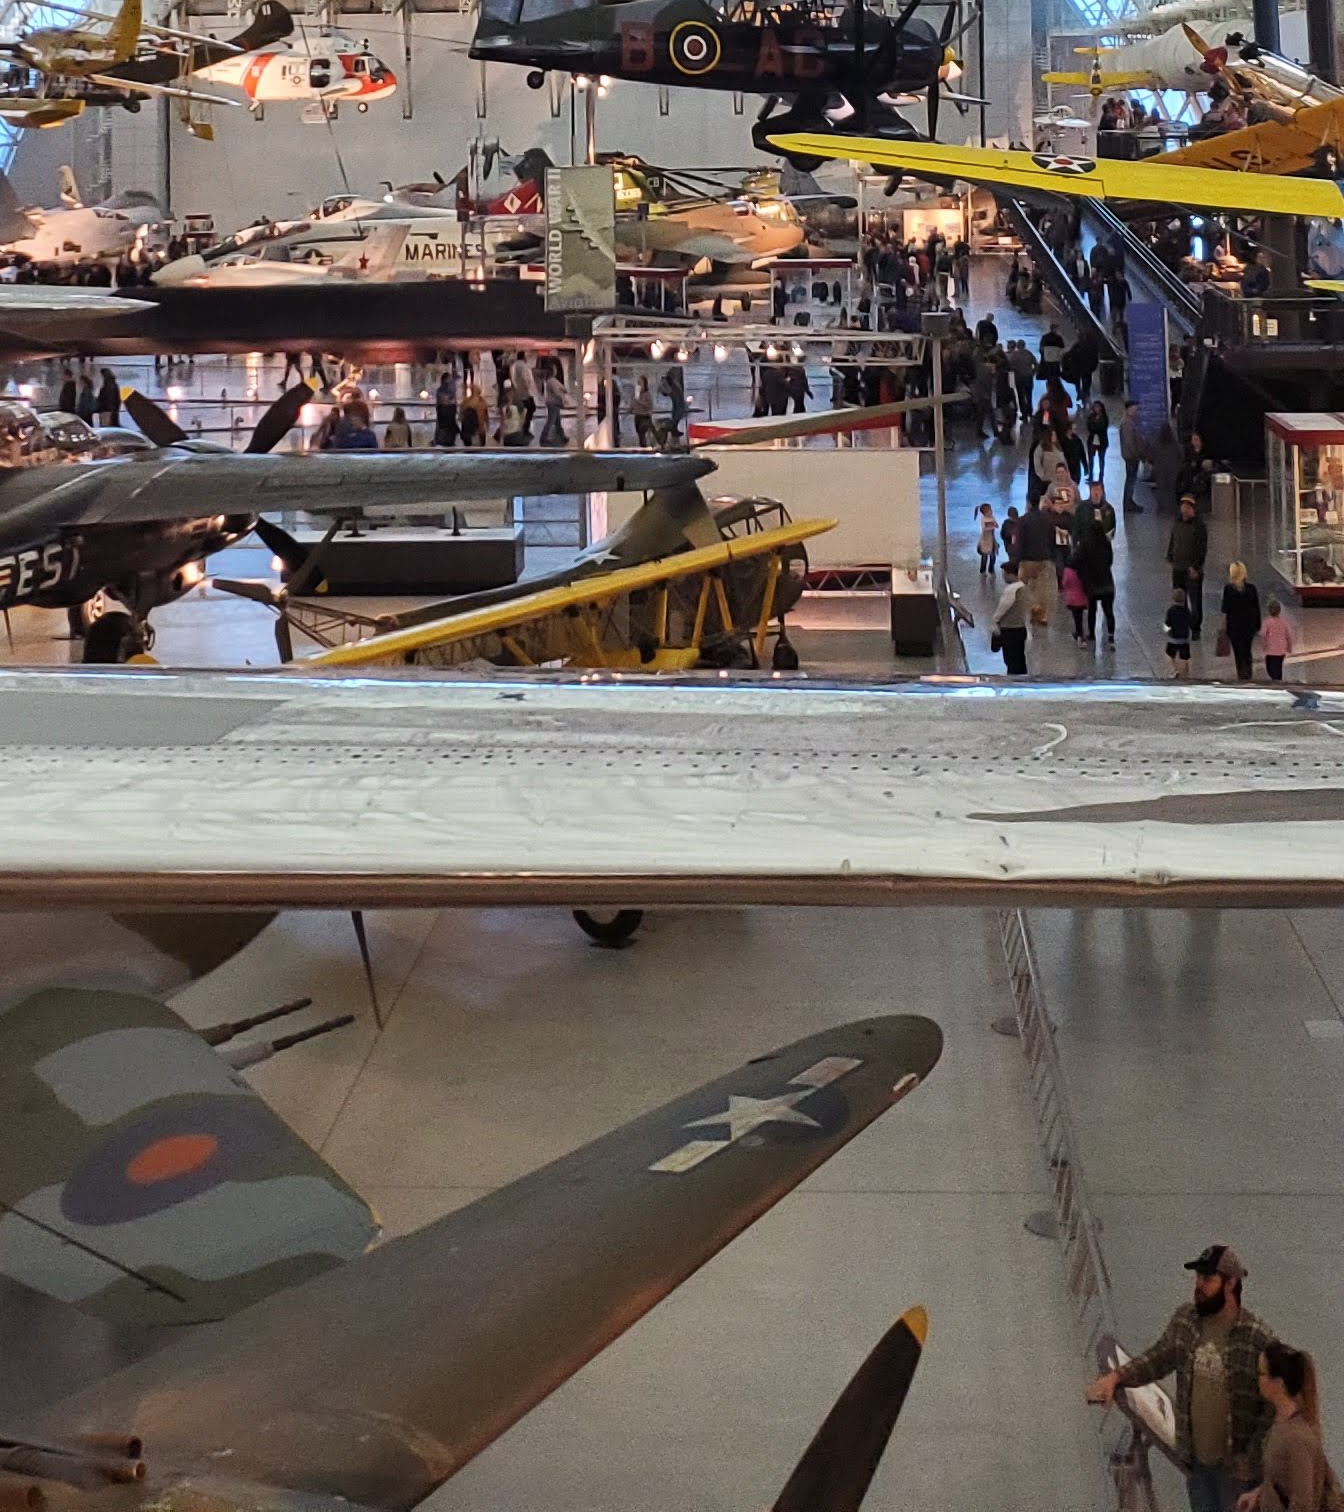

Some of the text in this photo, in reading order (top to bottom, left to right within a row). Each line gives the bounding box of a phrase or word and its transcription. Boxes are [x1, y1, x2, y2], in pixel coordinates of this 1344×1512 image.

[620, 20, 655, 72] B
[548, 180, 563, 224] WAR
[548, 229, 563, 295] WORLD
